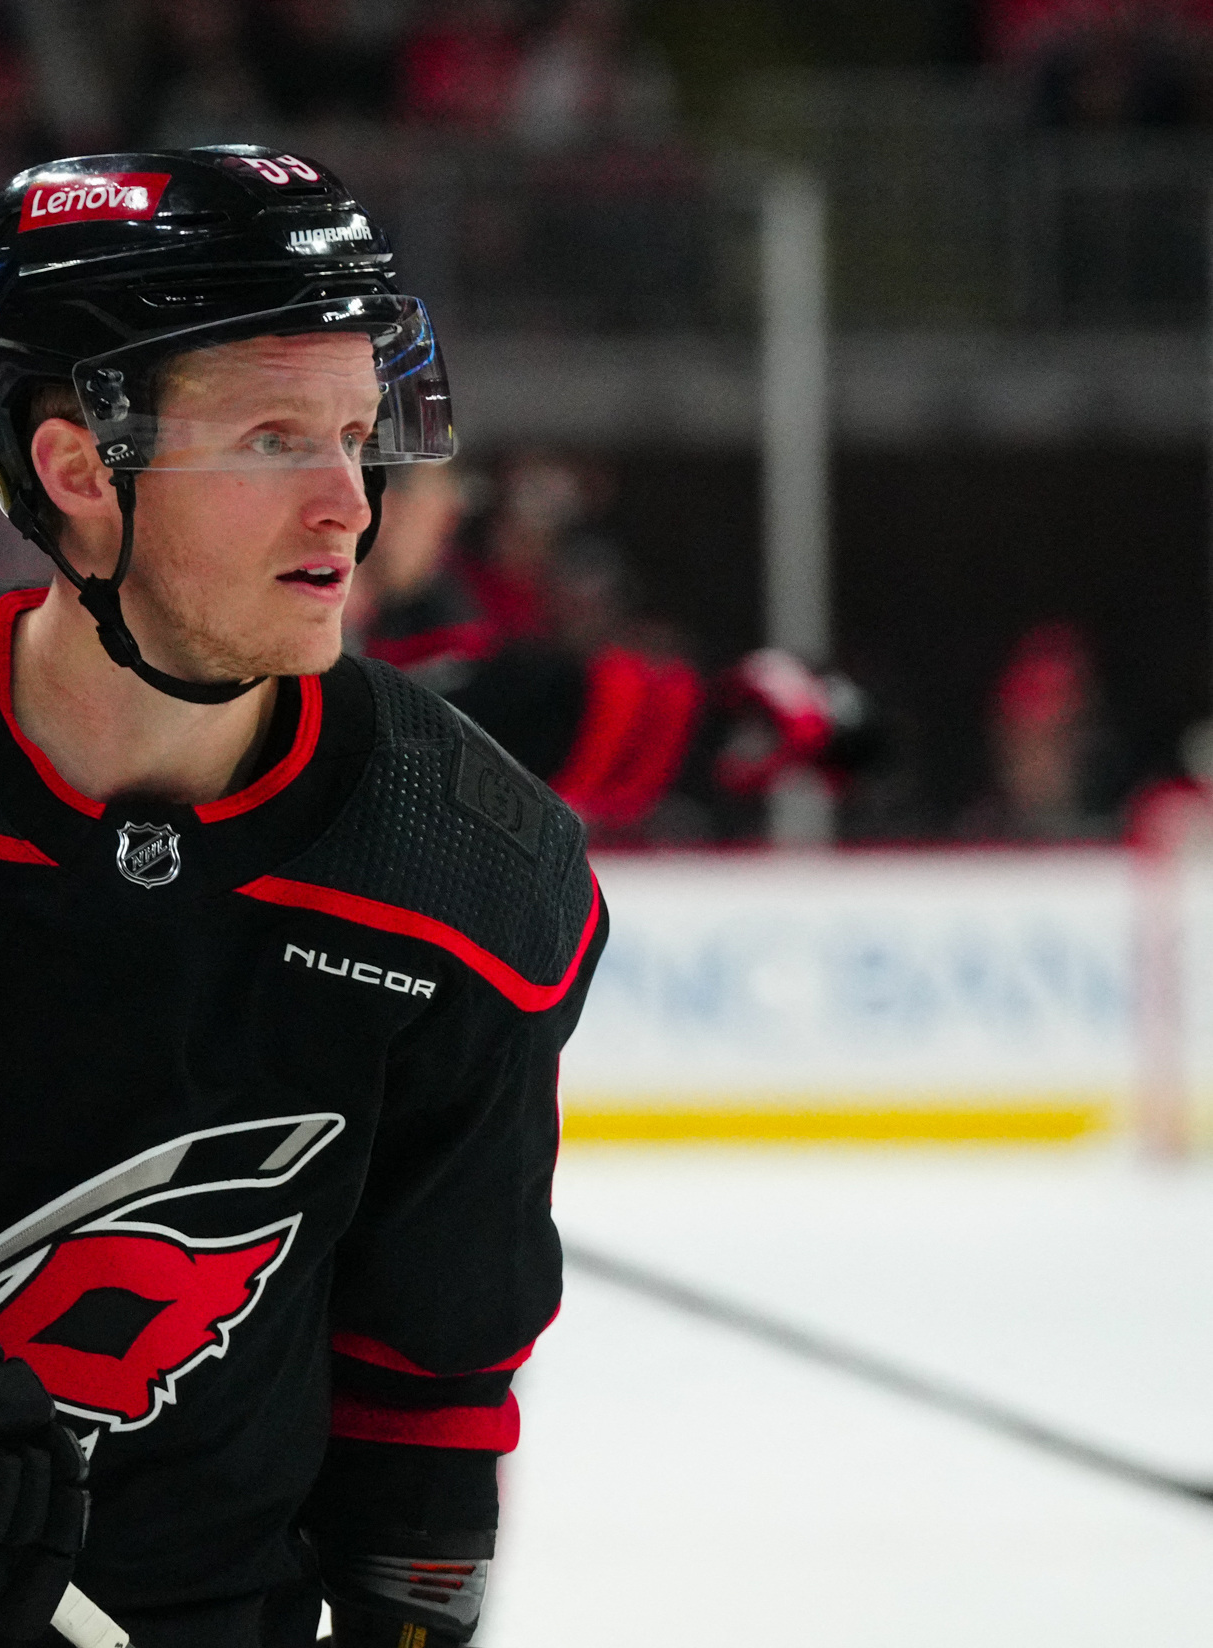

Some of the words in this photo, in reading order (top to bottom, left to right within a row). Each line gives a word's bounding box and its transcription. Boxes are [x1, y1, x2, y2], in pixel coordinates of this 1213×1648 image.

[239, 154, 320, 185] 59
[30, 186, 149, 217] Lenovo
[290, 226, 373, 246] WARRIOR
[131, 838, 168, 871] NHL
[284, 943, 436, 999] NUCOR
